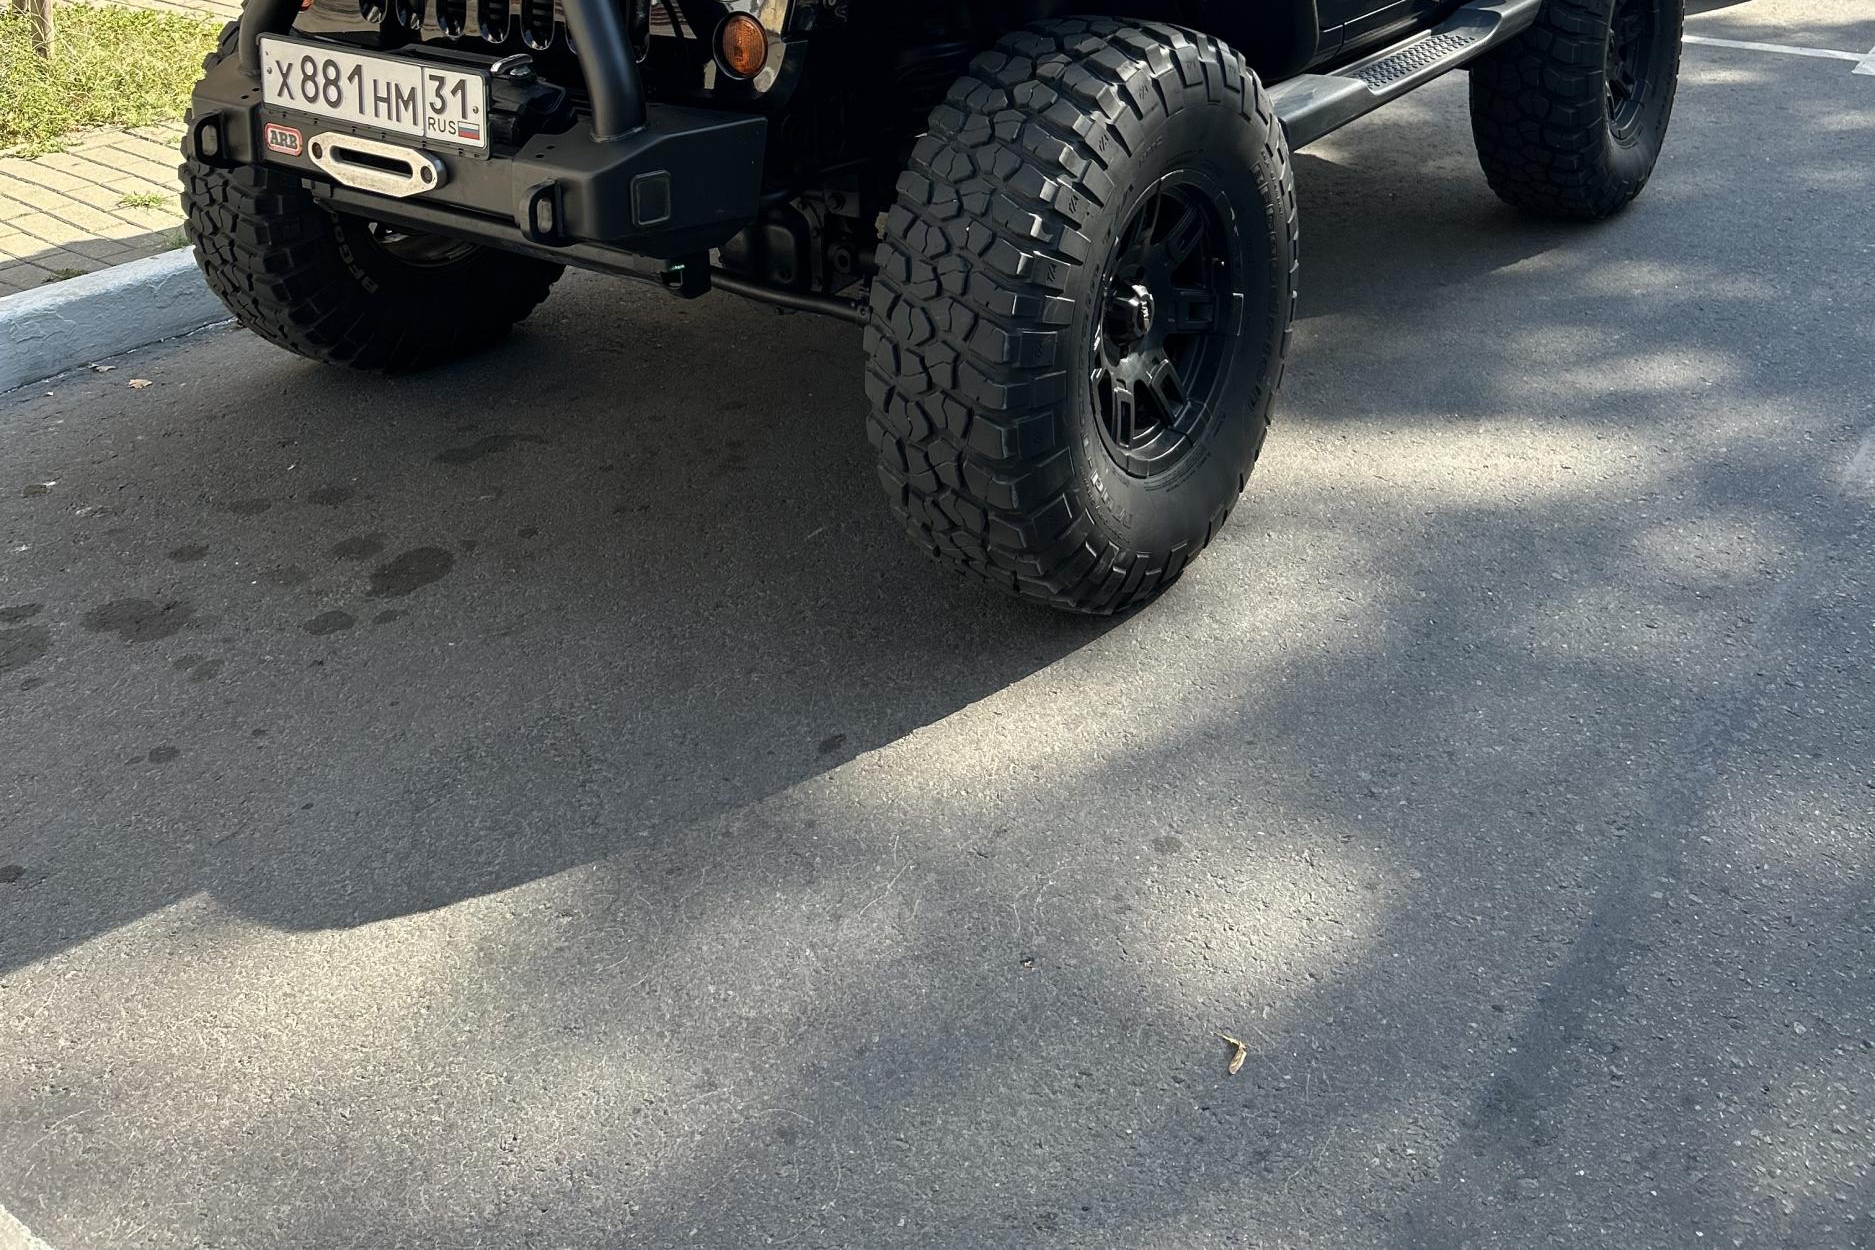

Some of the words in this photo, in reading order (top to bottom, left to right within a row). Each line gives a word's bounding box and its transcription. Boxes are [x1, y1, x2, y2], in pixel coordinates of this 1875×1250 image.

[428, 74, 468, 121] 31
[427, 116, 457, 135] RUS
[269, 129, 299, 150] ARB
